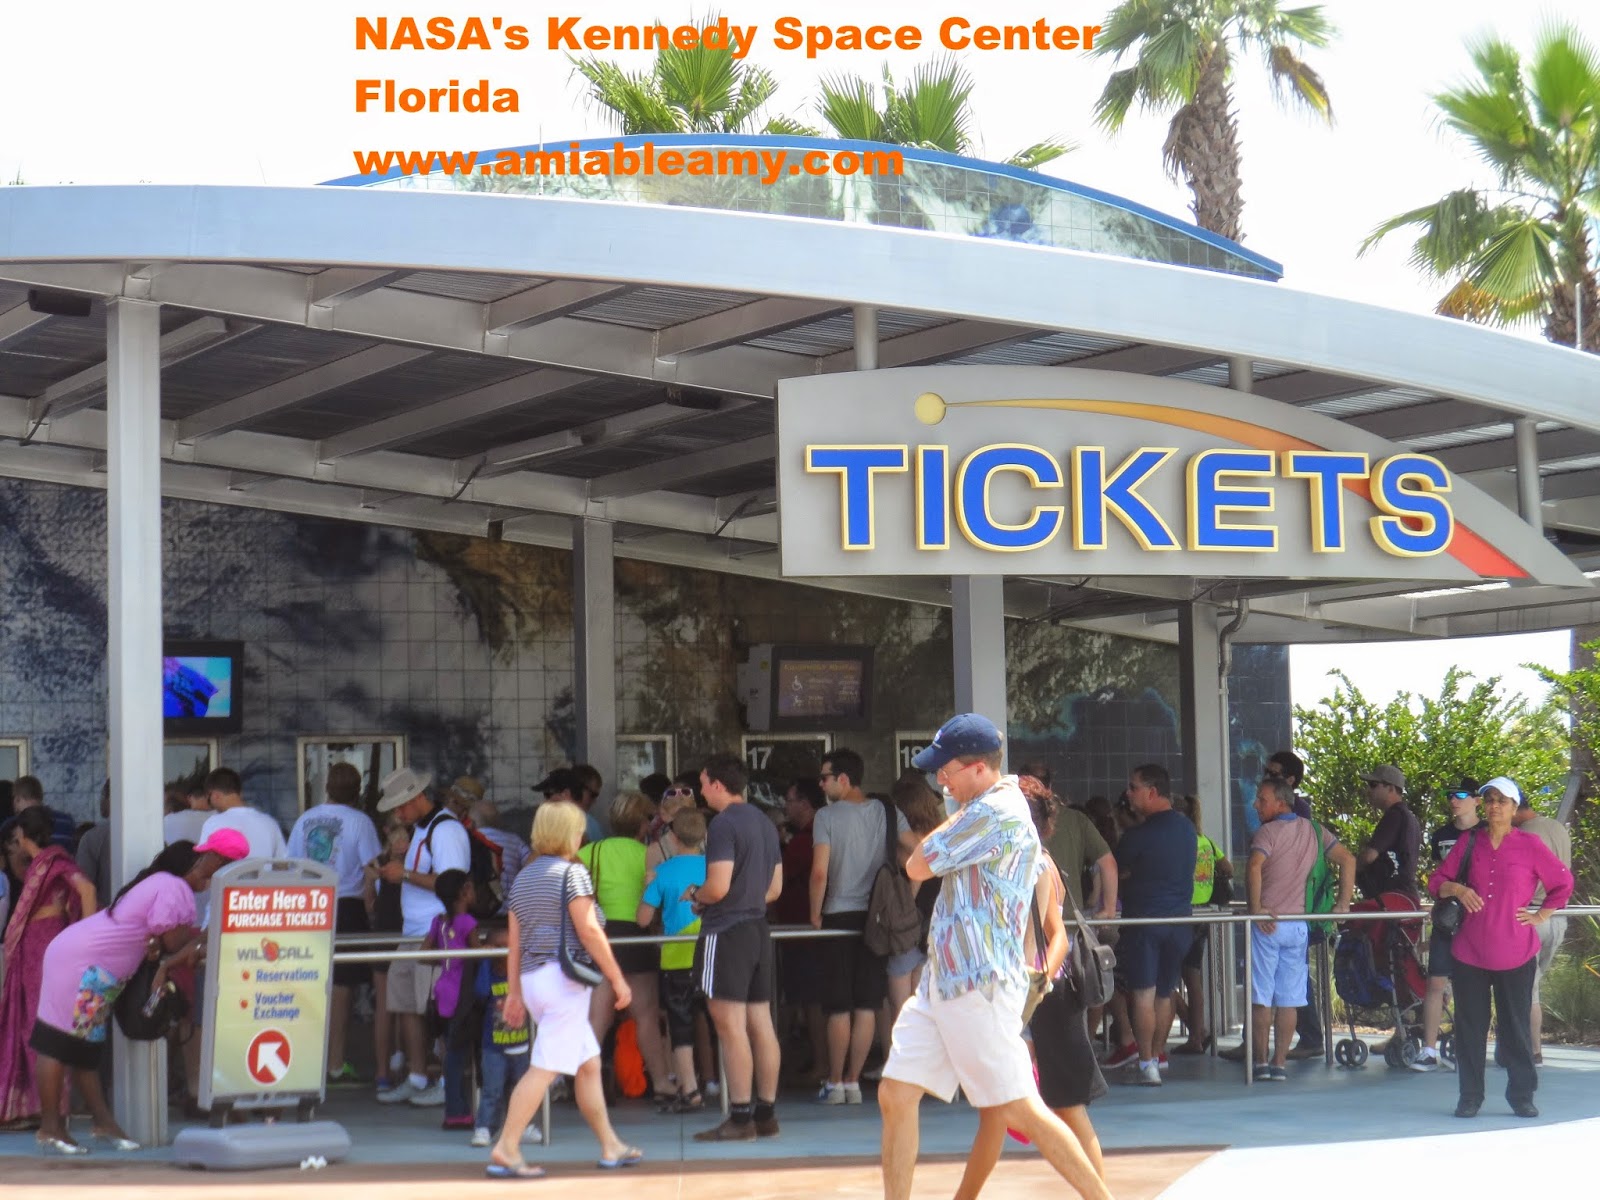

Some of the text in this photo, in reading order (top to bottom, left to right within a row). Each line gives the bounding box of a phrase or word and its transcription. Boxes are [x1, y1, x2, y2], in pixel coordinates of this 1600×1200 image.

[805, 443, 1455, 558] TICKETS
[748, 747, 773, 770] 17
[229, 889, 328, 910] Enter Here To
[228, 912, 327, 928] PURCHASE TICKETS
[237, 946, 314, 961] WIL CALL
[256, 968, 319, 982] Reservations
[255, 992, 294, 1004] Voucher
[254, 1006, 300, 1020] Exchange
